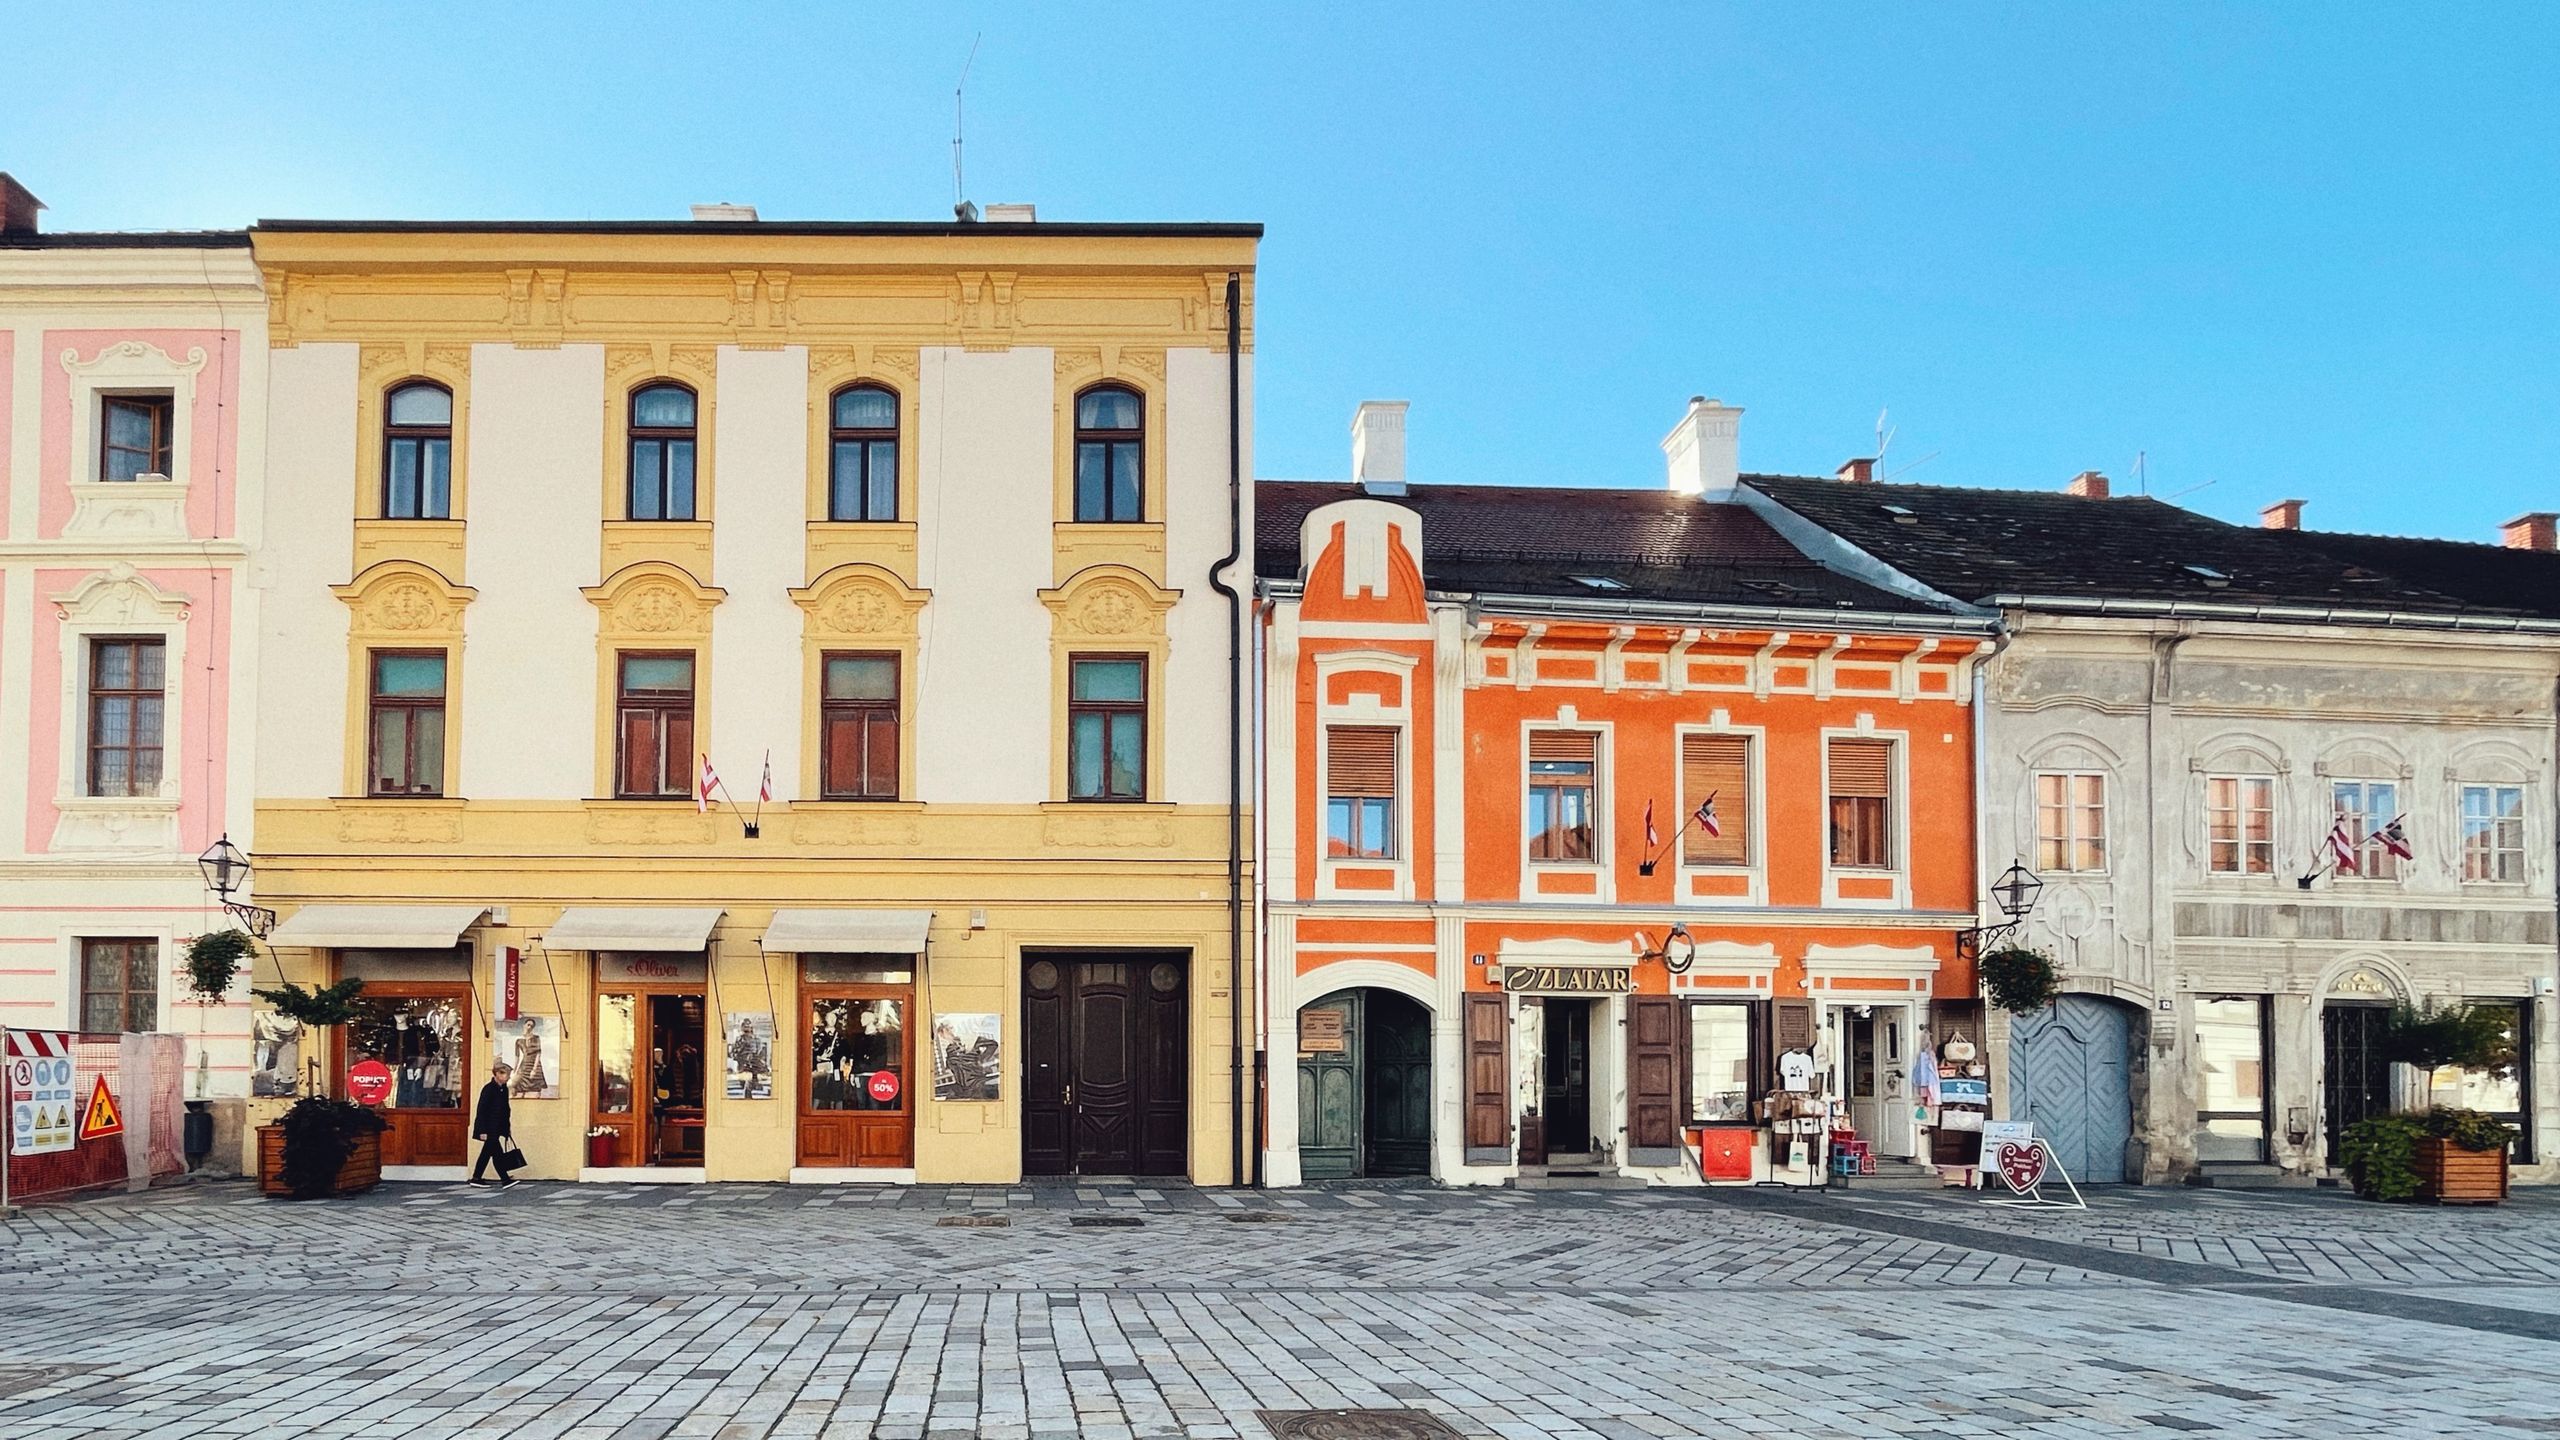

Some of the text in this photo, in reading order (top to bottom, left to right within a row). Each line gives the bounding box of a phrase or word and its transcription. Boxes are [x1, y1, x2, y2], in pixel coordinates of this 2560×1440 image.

[626, 958, 680, 977] s.Oliver
[1536, 968, 1628, 990] ZLATAR
[873, 1083, 894, 1093] 50%
